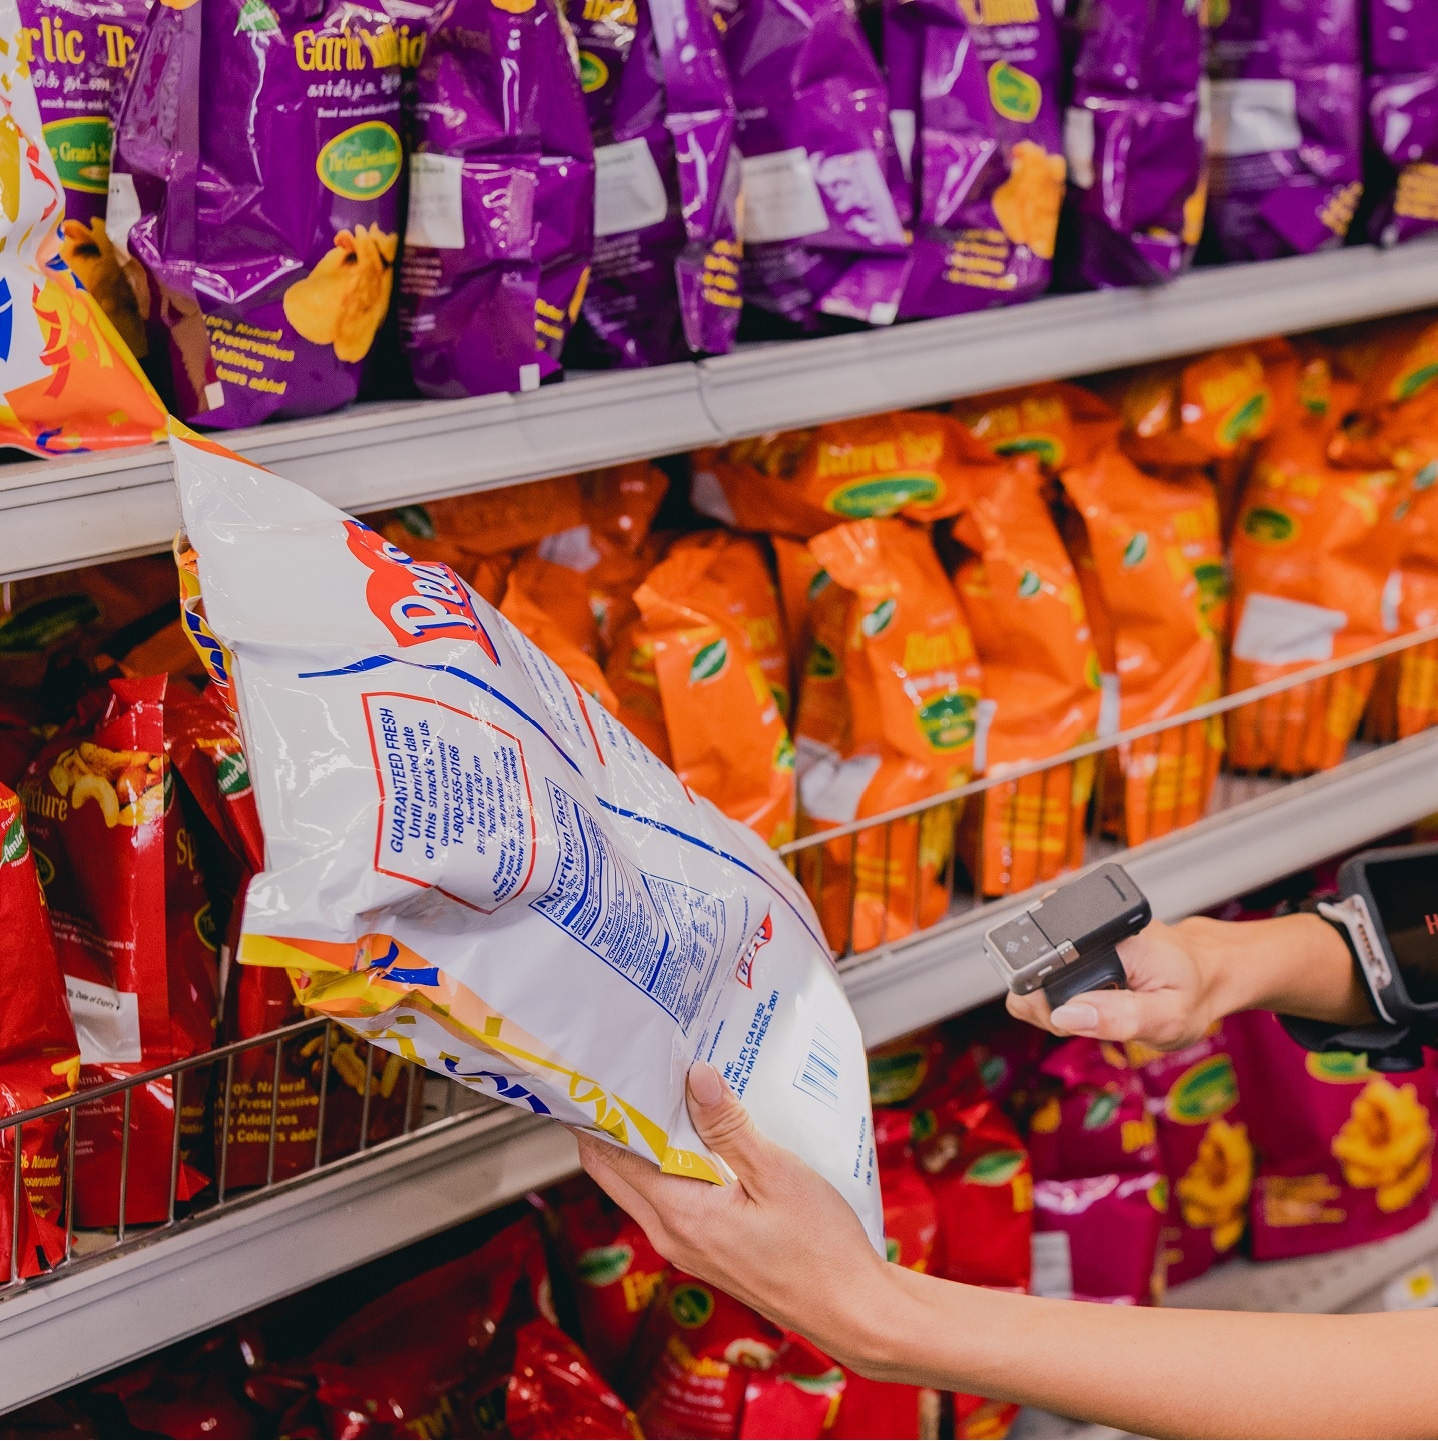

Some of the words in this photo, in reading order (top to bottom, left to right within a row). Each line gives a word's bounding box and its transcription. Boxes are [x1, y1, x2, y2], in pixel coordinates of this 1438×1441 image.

[379, 706, 400, 749] FRESH
[405, 726, 417, 752] date
[417, 719, 430, 735] us.
[421, 739, 432, 754] on
[436, 735, 449, 788] Comments?
[406, 752, 425, 802] printed
[473, 754, 483, 774] pm
[500, 745, 512, 783] numbers
[423, 757, 437, 808] snack's
[443, 790, 450, 800] or
[448, 744, 463, 844] 1-800-555-0166
[475, 771, 485, 796] 4:30
[495, 775, 510, 814] product
[388, 752, 403, 853] GUARANTEED
[476, 797, 484, 808] to
[1, 812, 16, 830] From
[409, 803, 422, 838] Until
[425, 812, 436, 837] this
[439, 802, 449, 846] Question
[479, 811, 487, 828] am
[424, 841, 434, 859] or
[511, 845, 525, 876] below
[535, 831, 571, 909] Nutrition
[554, 788, 567, 828] Facts
[491, 848, 505, 884] Please
[505, 853, 516, 876] size,
[493, 877, 509, 897] bag
[547, 890, 569, 915] Serving
[565, 872, 579, 890] Size
[553, 890, 579, 921] Servings
[574, 877, 584, 891] Per
[570, 907, 587, 931] Amount
[577, 905, 598, 936] Calories
[593, 929, 607, 947] Total
[603, 915, 613, 930] Fat
[608, 915, 629, 959] Cholesterol
[614, 935, 631, 965] Sodium
[620, 950, 633, 969] Total
[641, 959, 656, 986] Protein
[652, 968, 666, 993] Vitamin
[730, 1045, 751, 1082] VALLEY,
[746, 1030, 756, 1044] CA
[751, 1002, 766, 1029] 91352
[744, 1046, 759, 1074] HAYS
[754, 1013, 773, 1047] PRESS,
[766, 989, 779, 1011] 2001
[722, 1061, 735, 1079] INC.
[31, 1154, 59, 1169] Natural
